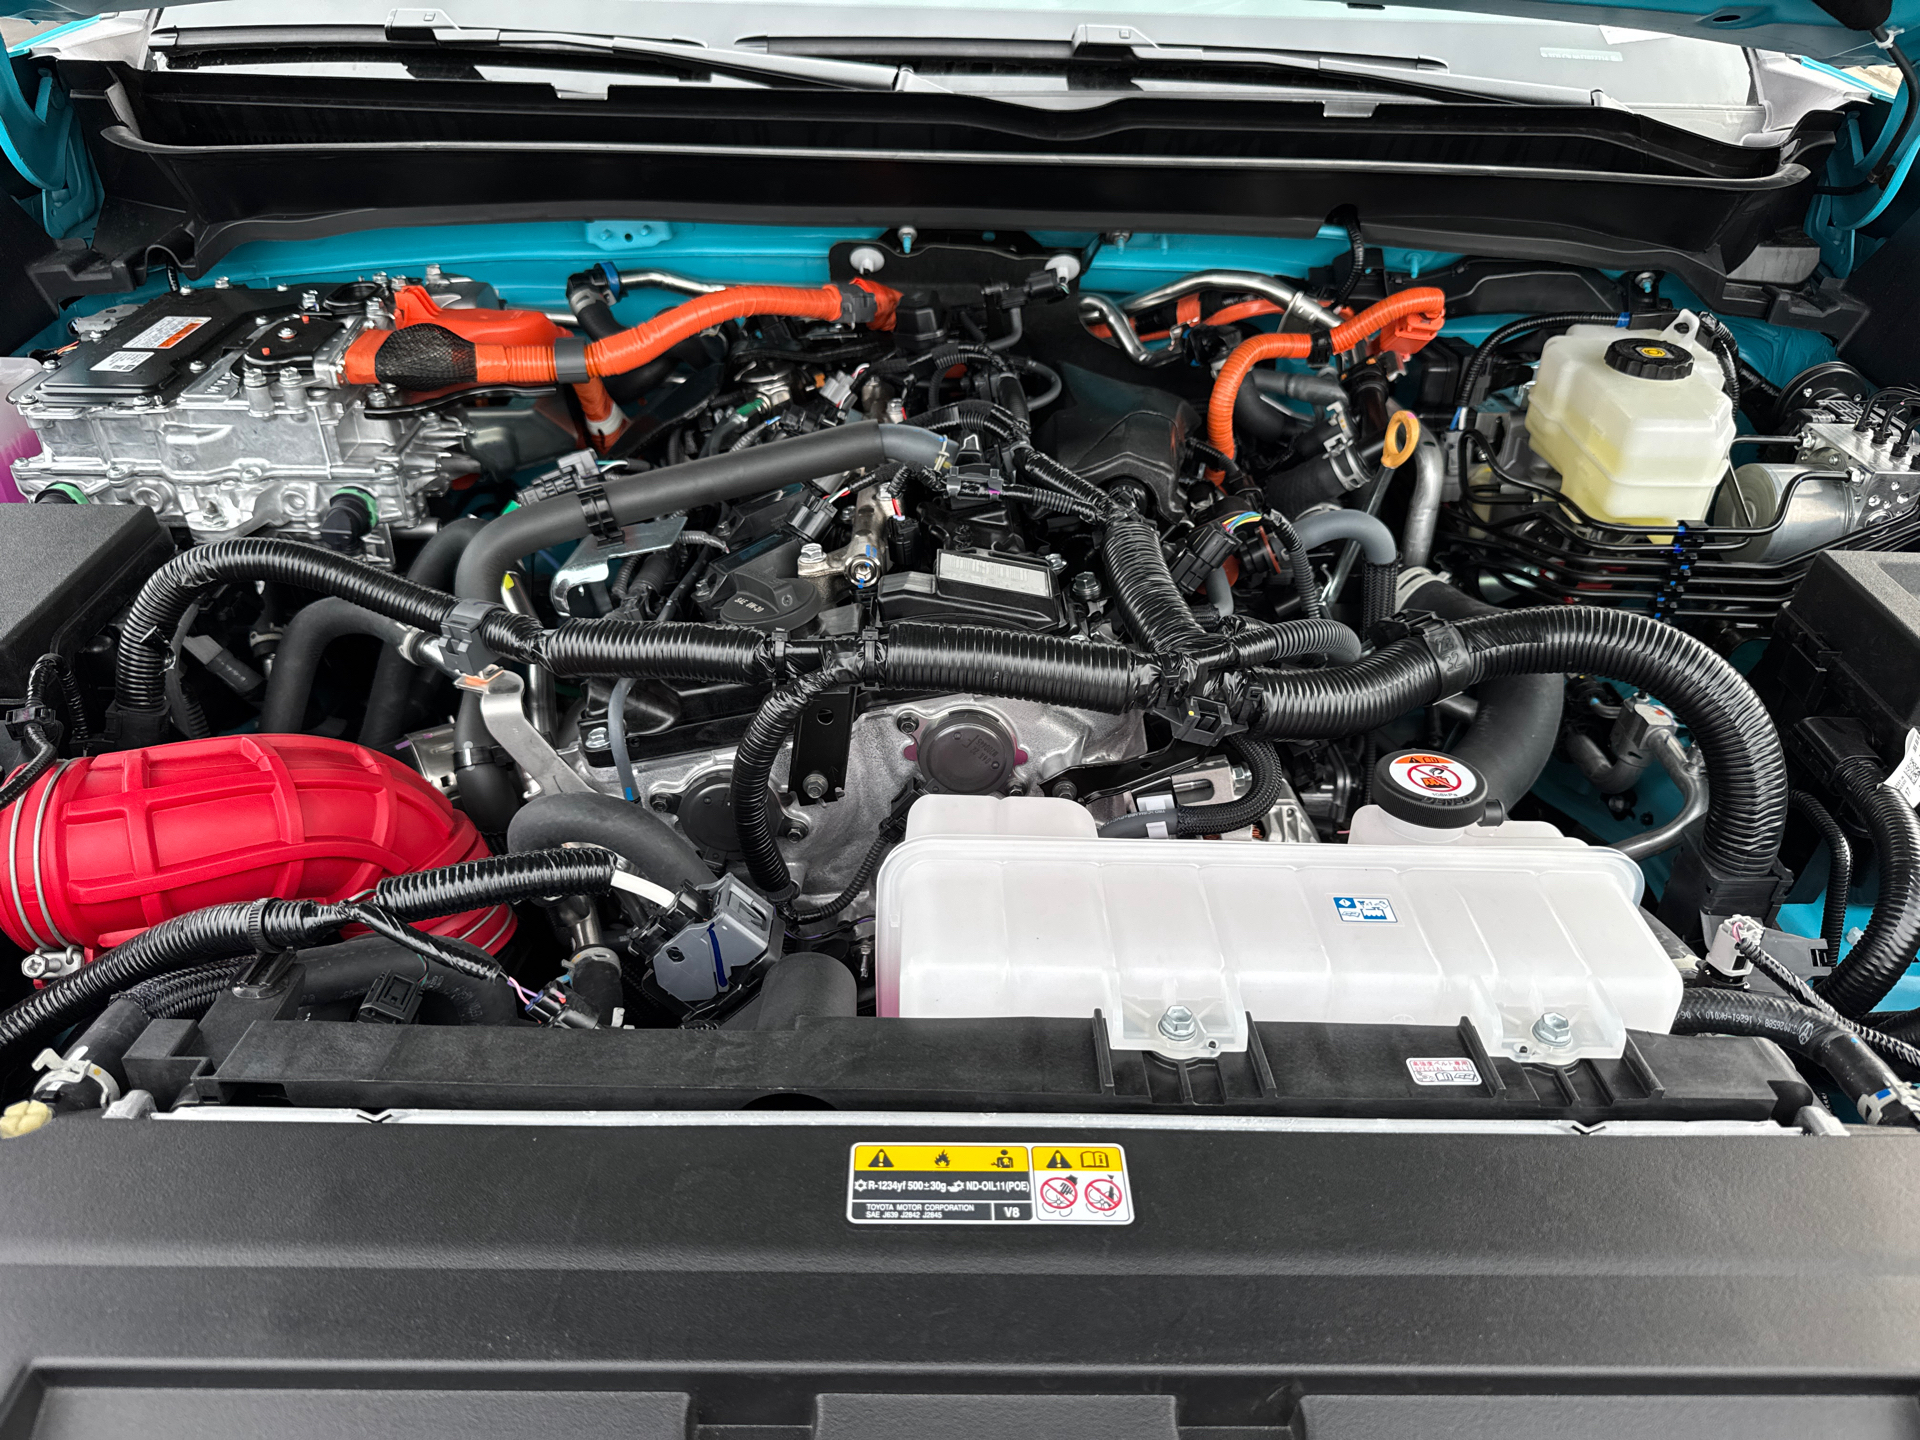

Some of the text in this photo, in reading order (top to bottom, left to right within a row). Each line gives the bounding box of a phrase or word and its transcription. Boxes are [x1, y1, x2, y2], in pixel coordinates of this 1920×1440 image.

[868, 1180, 1030, 1193] R-1234yf 500±30g ND-OIL11(POE)
[866, 1203, 975, 1212] TOYOTA MOTOR CORPORATION
[1003, 1206, 1020, 1218] V8
[866, 1211, 880, 1219] SAE
[882, 1211, 899, 1219] J639
[900, 1211, 921, 1219] J2842
